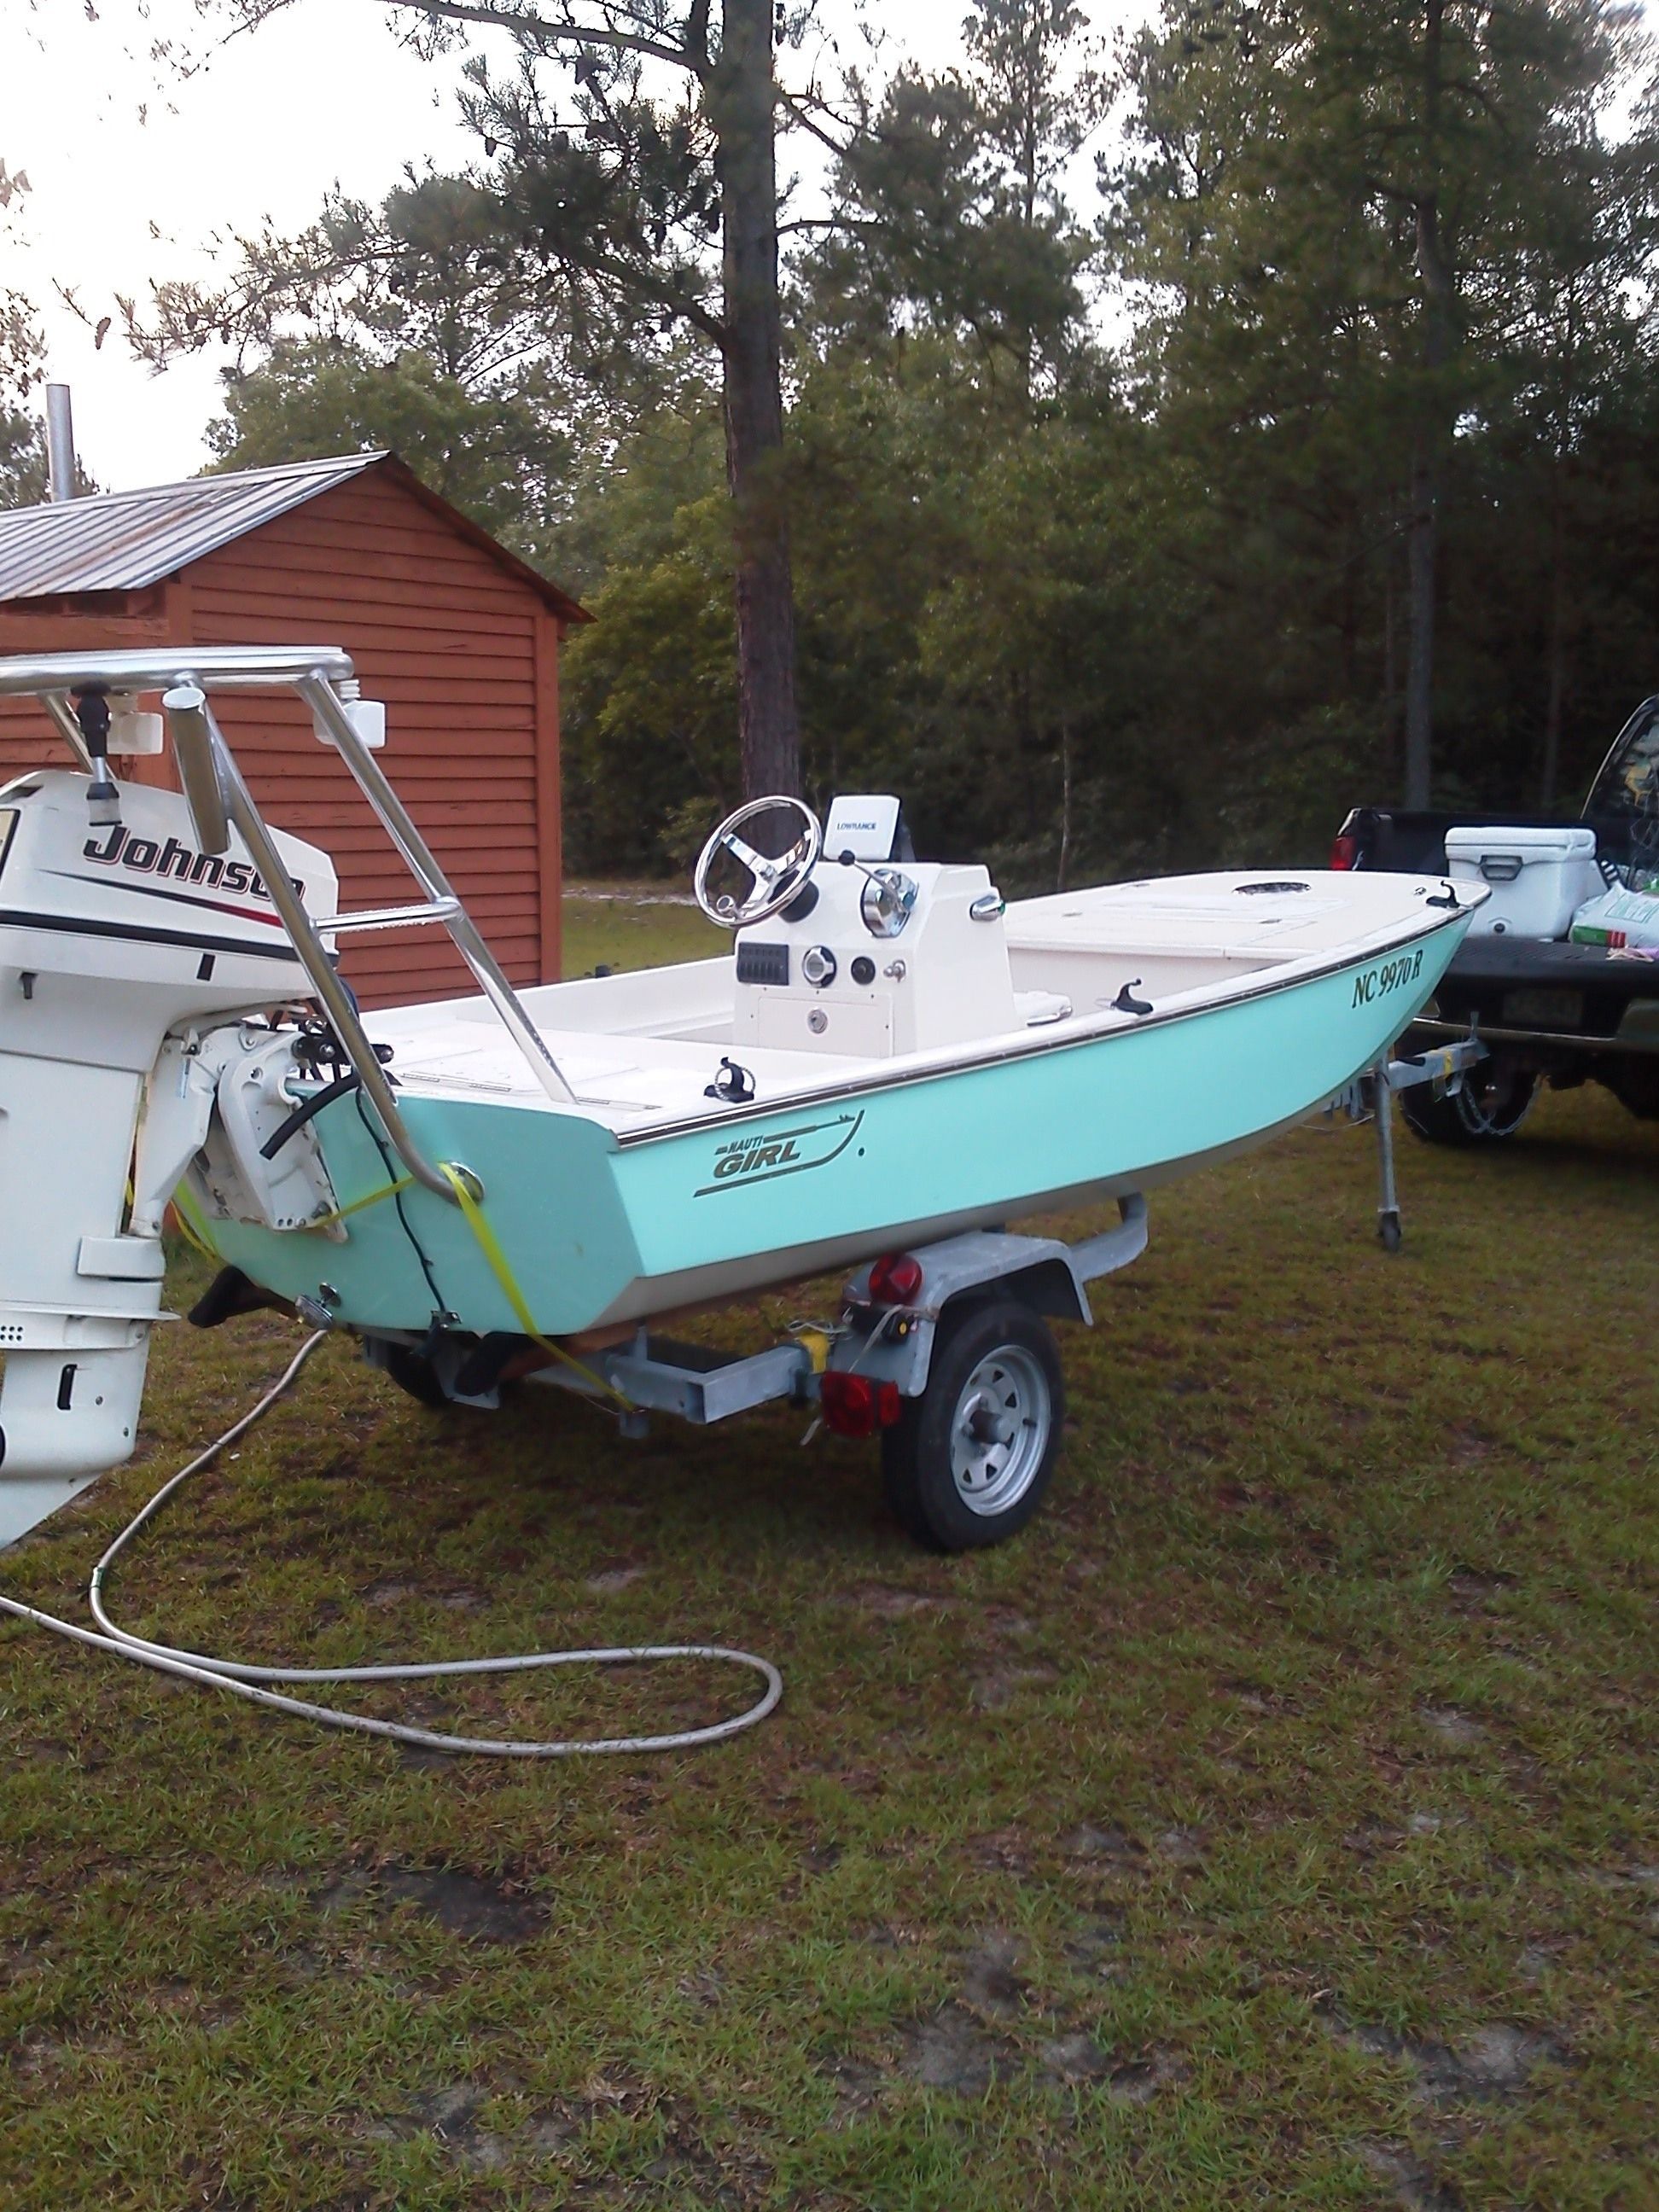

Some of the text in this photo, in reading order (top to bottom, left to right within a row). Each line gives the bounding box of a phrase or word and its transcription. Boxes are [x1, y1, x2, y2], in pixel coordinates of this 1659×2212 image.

[1352, 970, 1377, 1009] NC
[1378, 957, 1412, 997] 9970
[713, 1140, 800, 1179] GIRL
[728, 1135, 763, 1154] NAUTI
